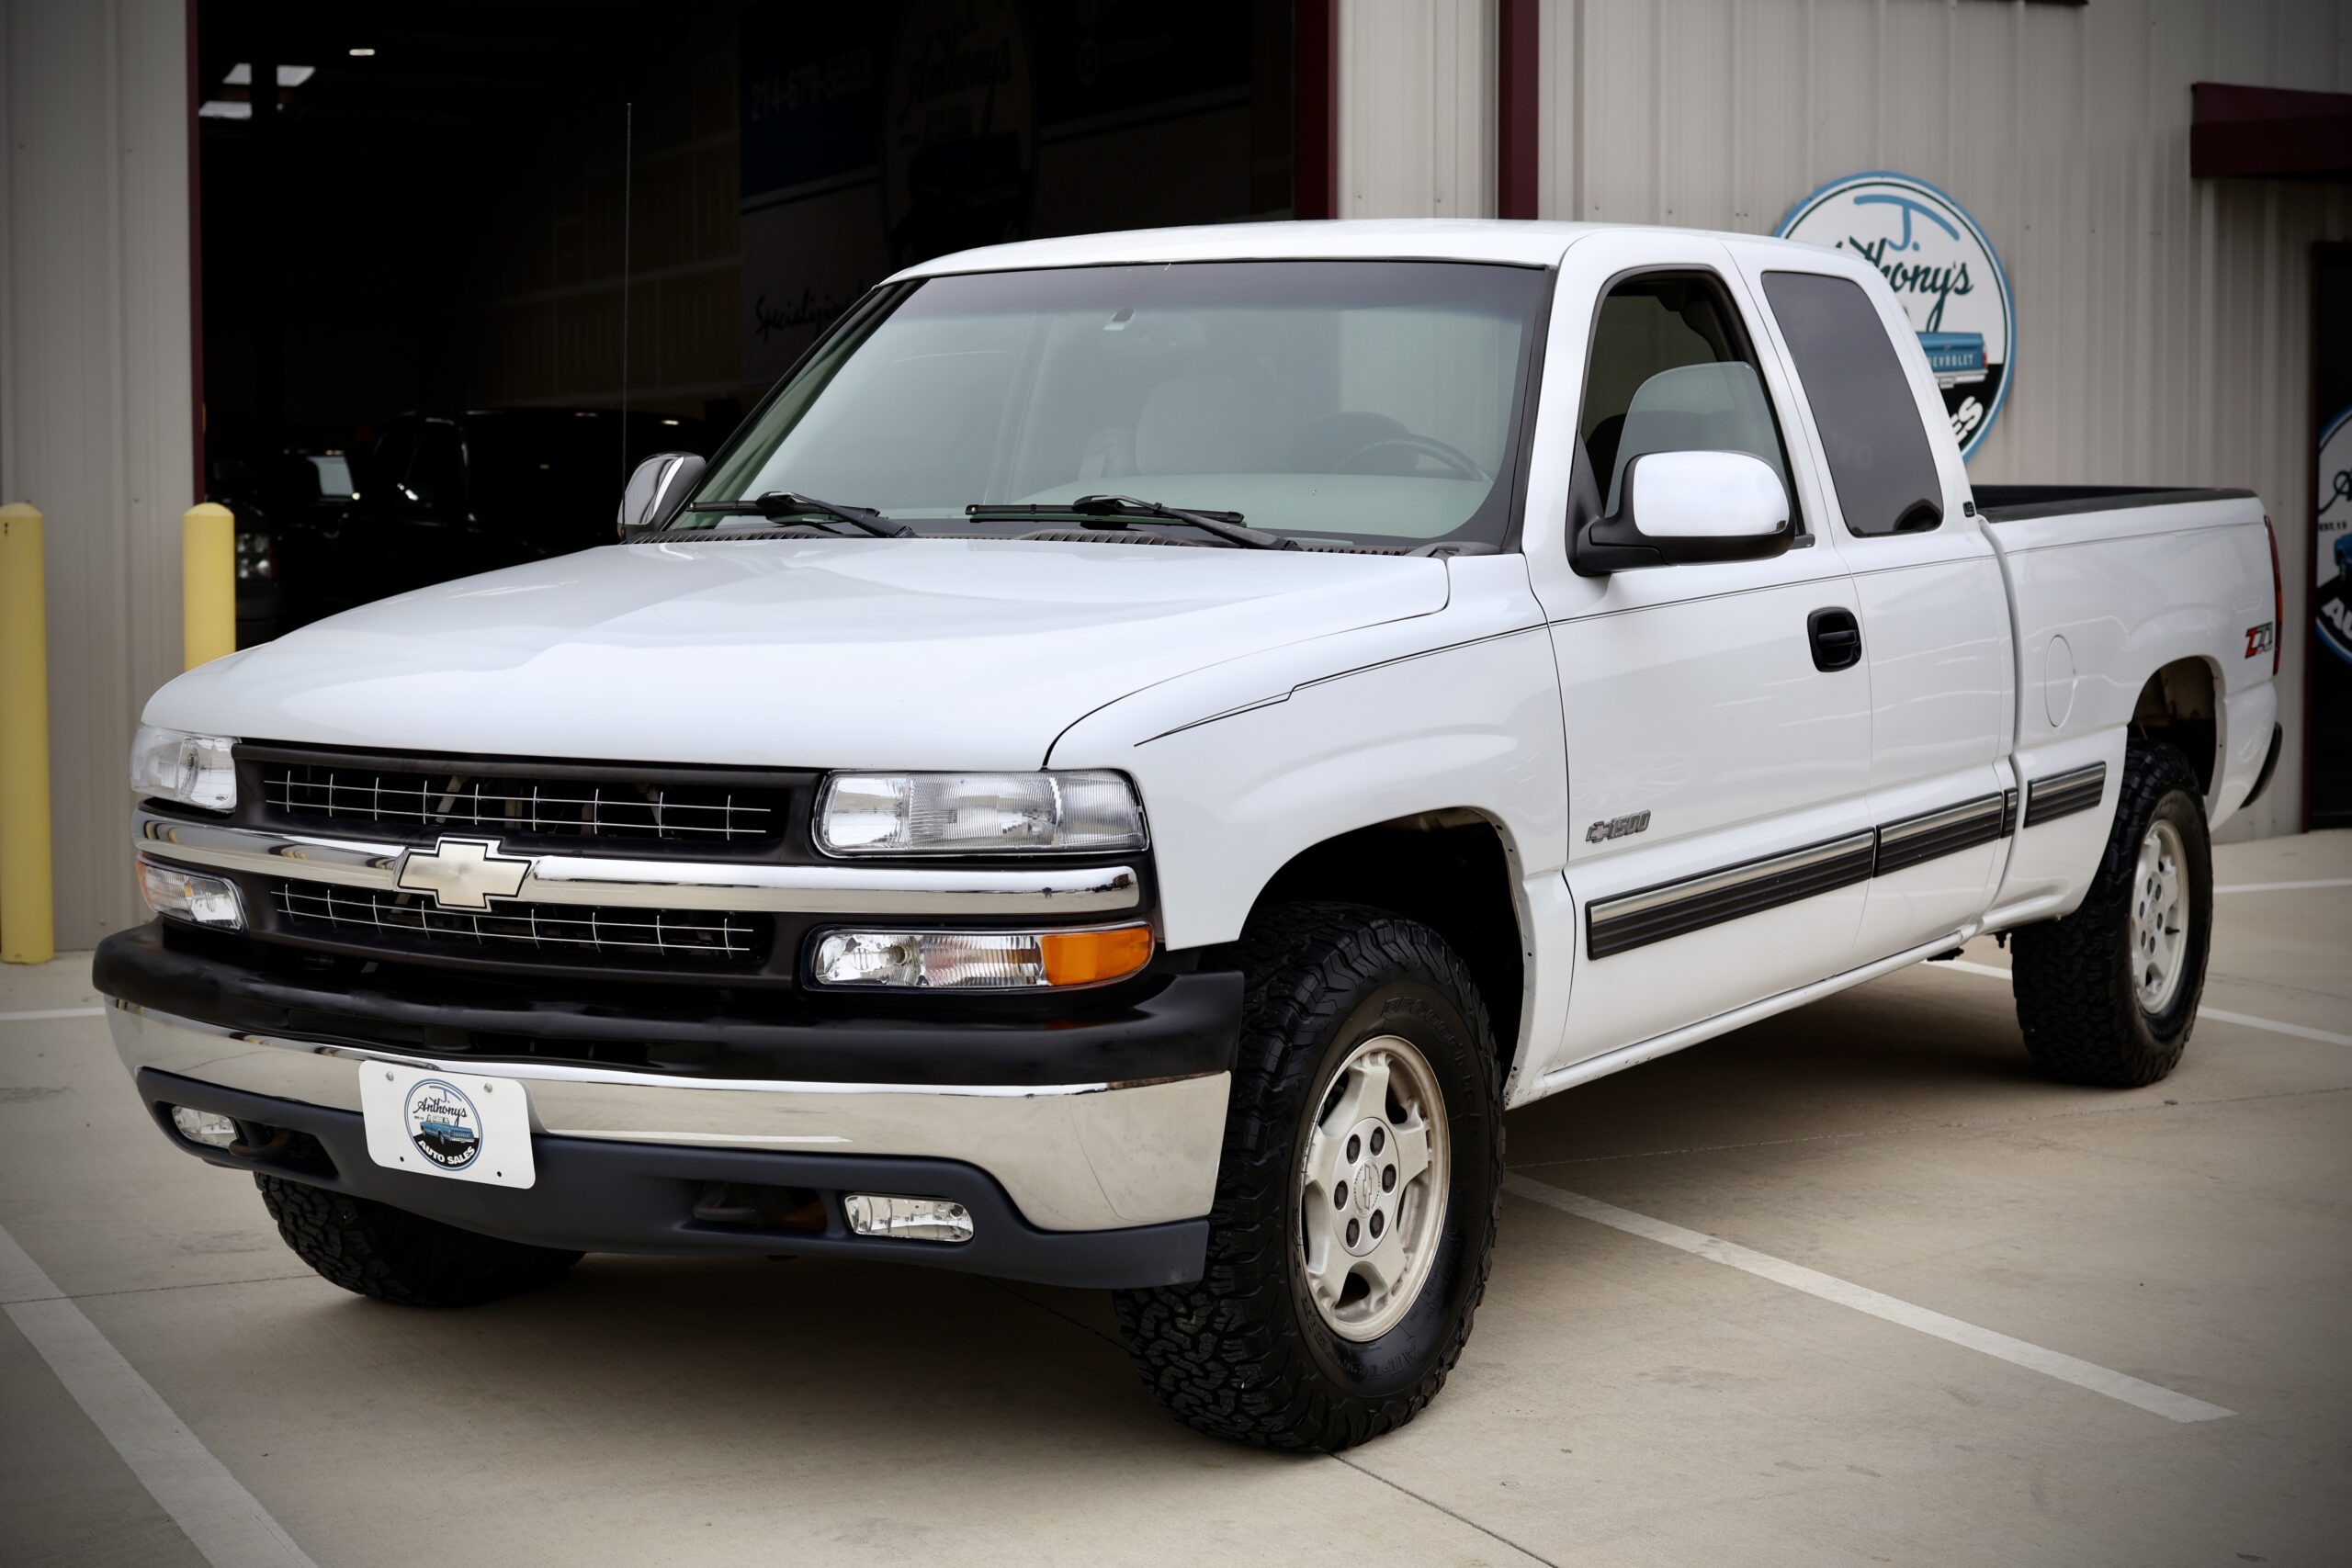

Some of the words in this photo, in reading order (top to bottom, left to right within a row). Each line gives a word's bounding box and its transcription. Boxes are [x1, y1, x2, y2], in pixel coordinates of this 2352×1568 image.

[1608, 809, 1651, 840] 1500
[413, 1096, 468, 1128] Anthony's
[418, 1140, 446, 1162] AUTO
[447, 1145, 475, 1165] SALES
